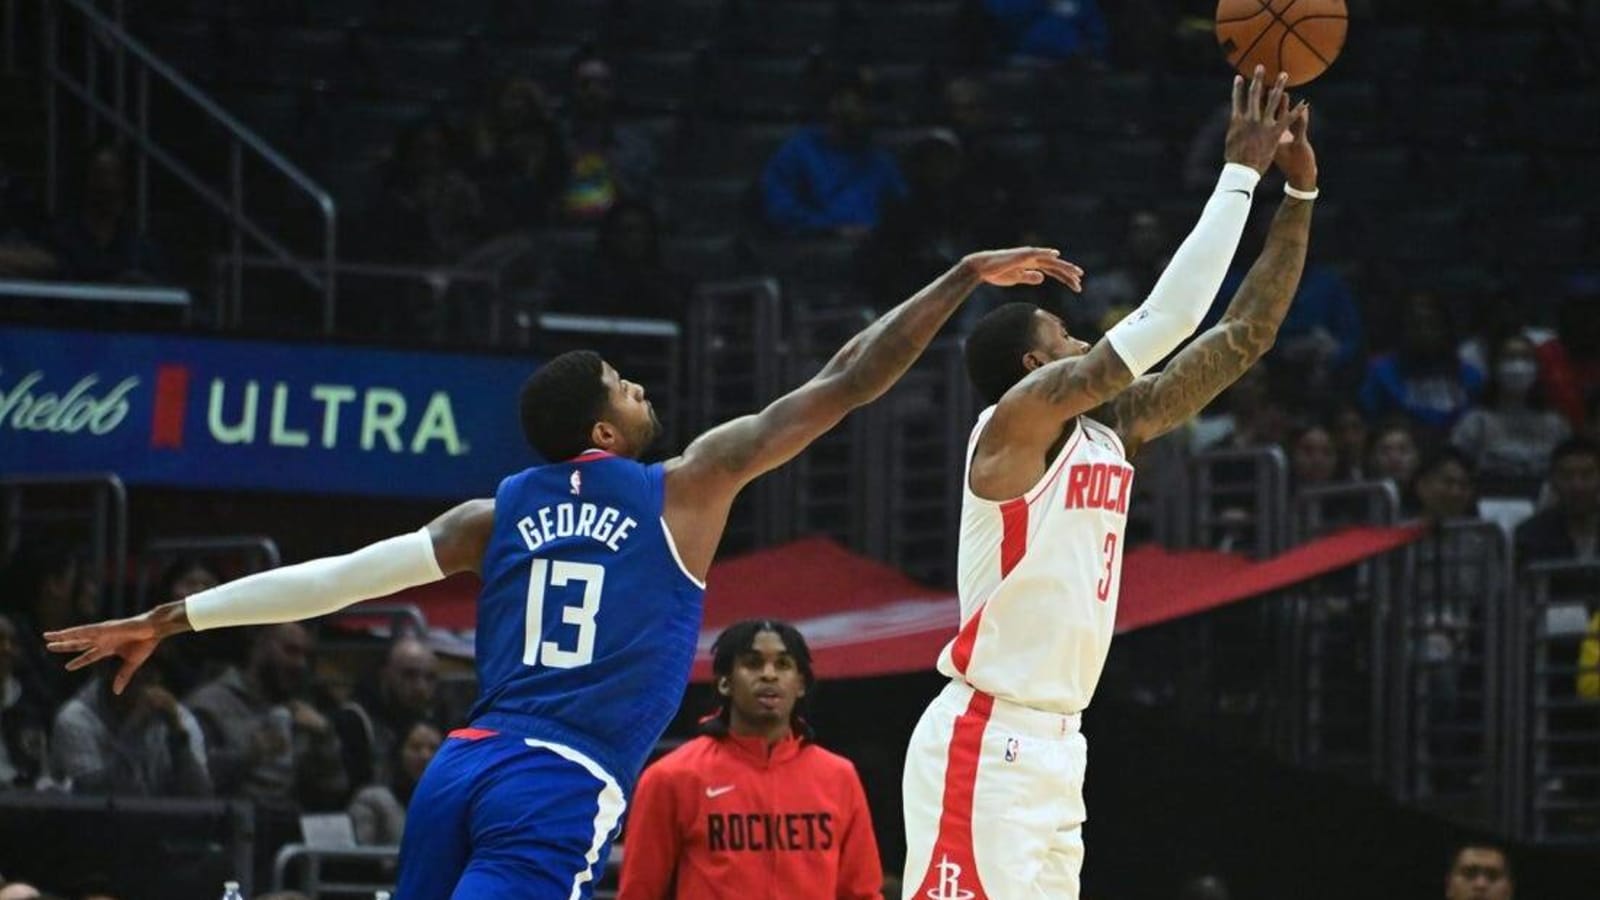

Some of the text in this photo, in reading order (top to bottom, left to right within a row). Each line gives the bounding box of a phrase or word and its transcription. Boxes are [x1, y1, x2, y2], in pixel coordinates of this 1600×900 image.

[0, 370, 464, 456] helob ULTRA
[1065, 463, 1133, 515] ROCK
[517, 502, 638, 552] GEORGE
[1097, 532, 1117, 602] 3
[522, 558, 605, 669] 13
[708, 813, 833, 851] ROCKETS
